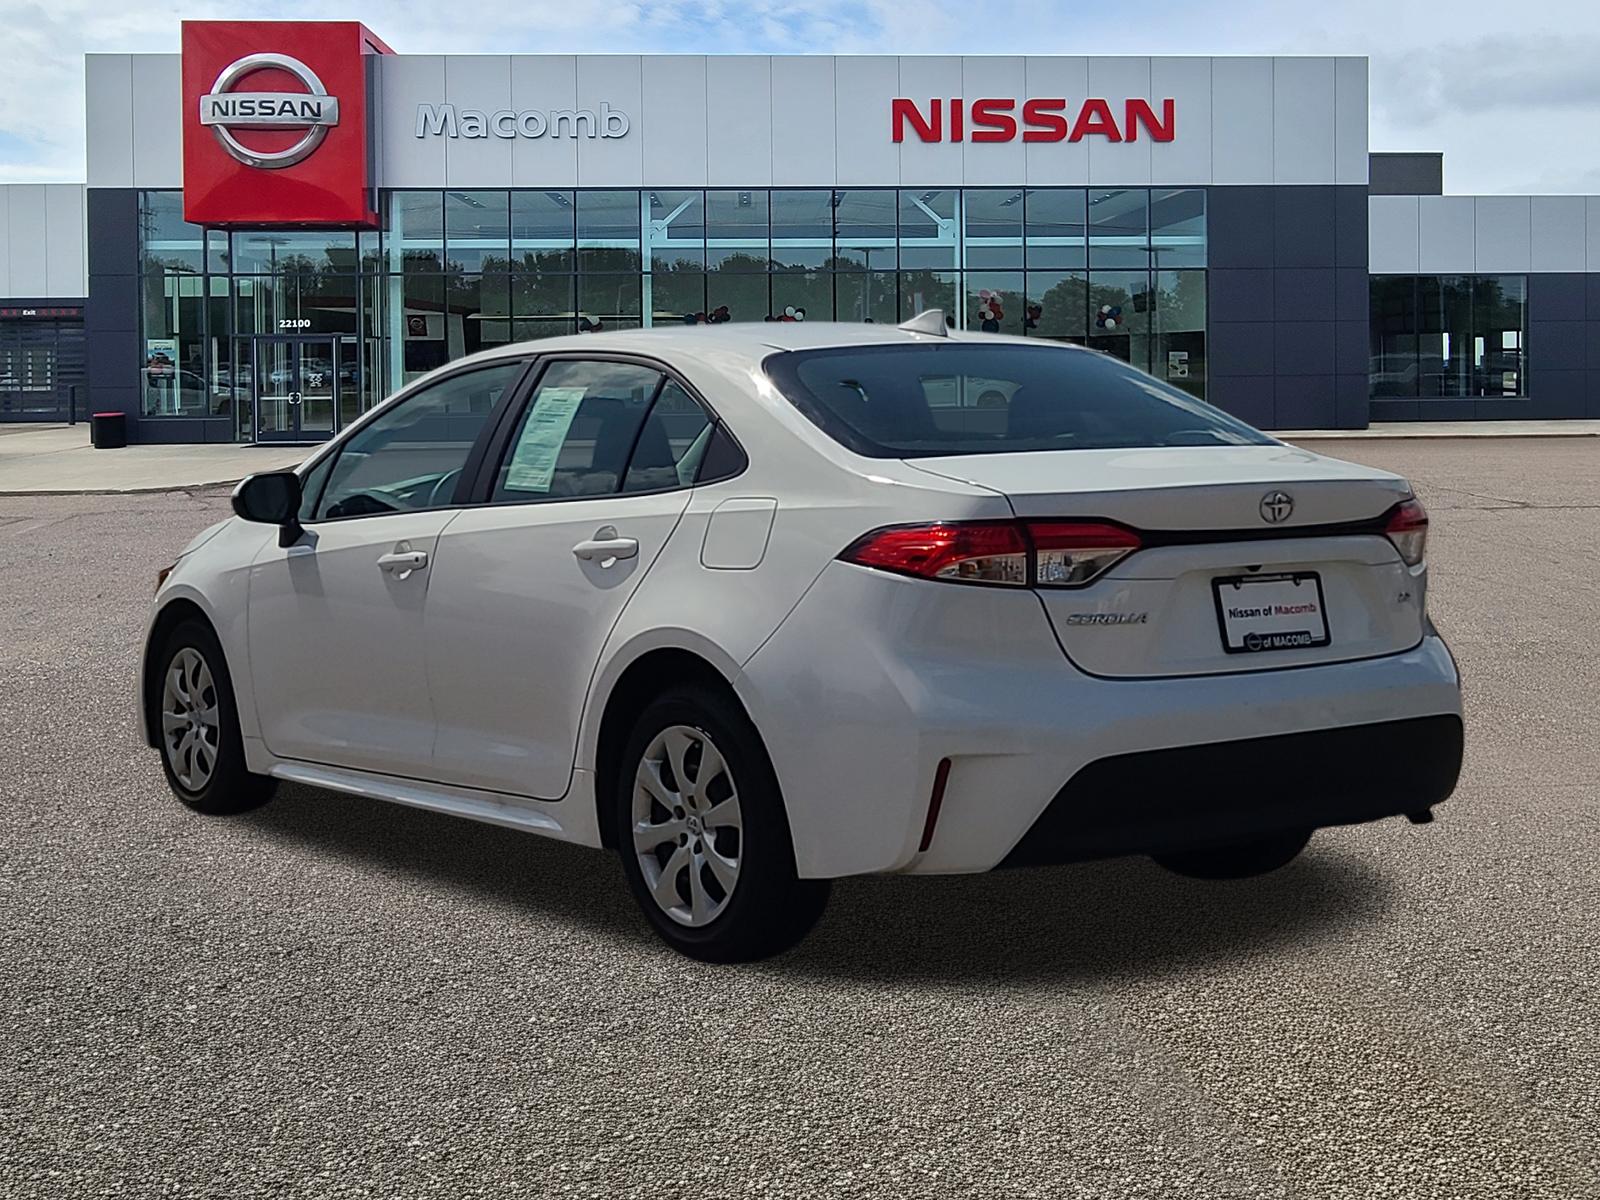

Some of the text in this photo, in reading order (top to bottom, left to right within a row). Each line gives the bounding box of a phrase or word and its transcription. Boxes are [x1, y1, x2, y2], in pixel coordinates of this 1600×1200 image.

[212, 100, 321, 117] NISSAN
[415, 101, 630, 138] Macomb
[892, 98, 1175, 143] NISSAN
[279, 319, 311, 328] 22100
[1228, 603, 1317, 619] Nissan of Macomb
[1273, 633, 1312, 647] MACOMB
